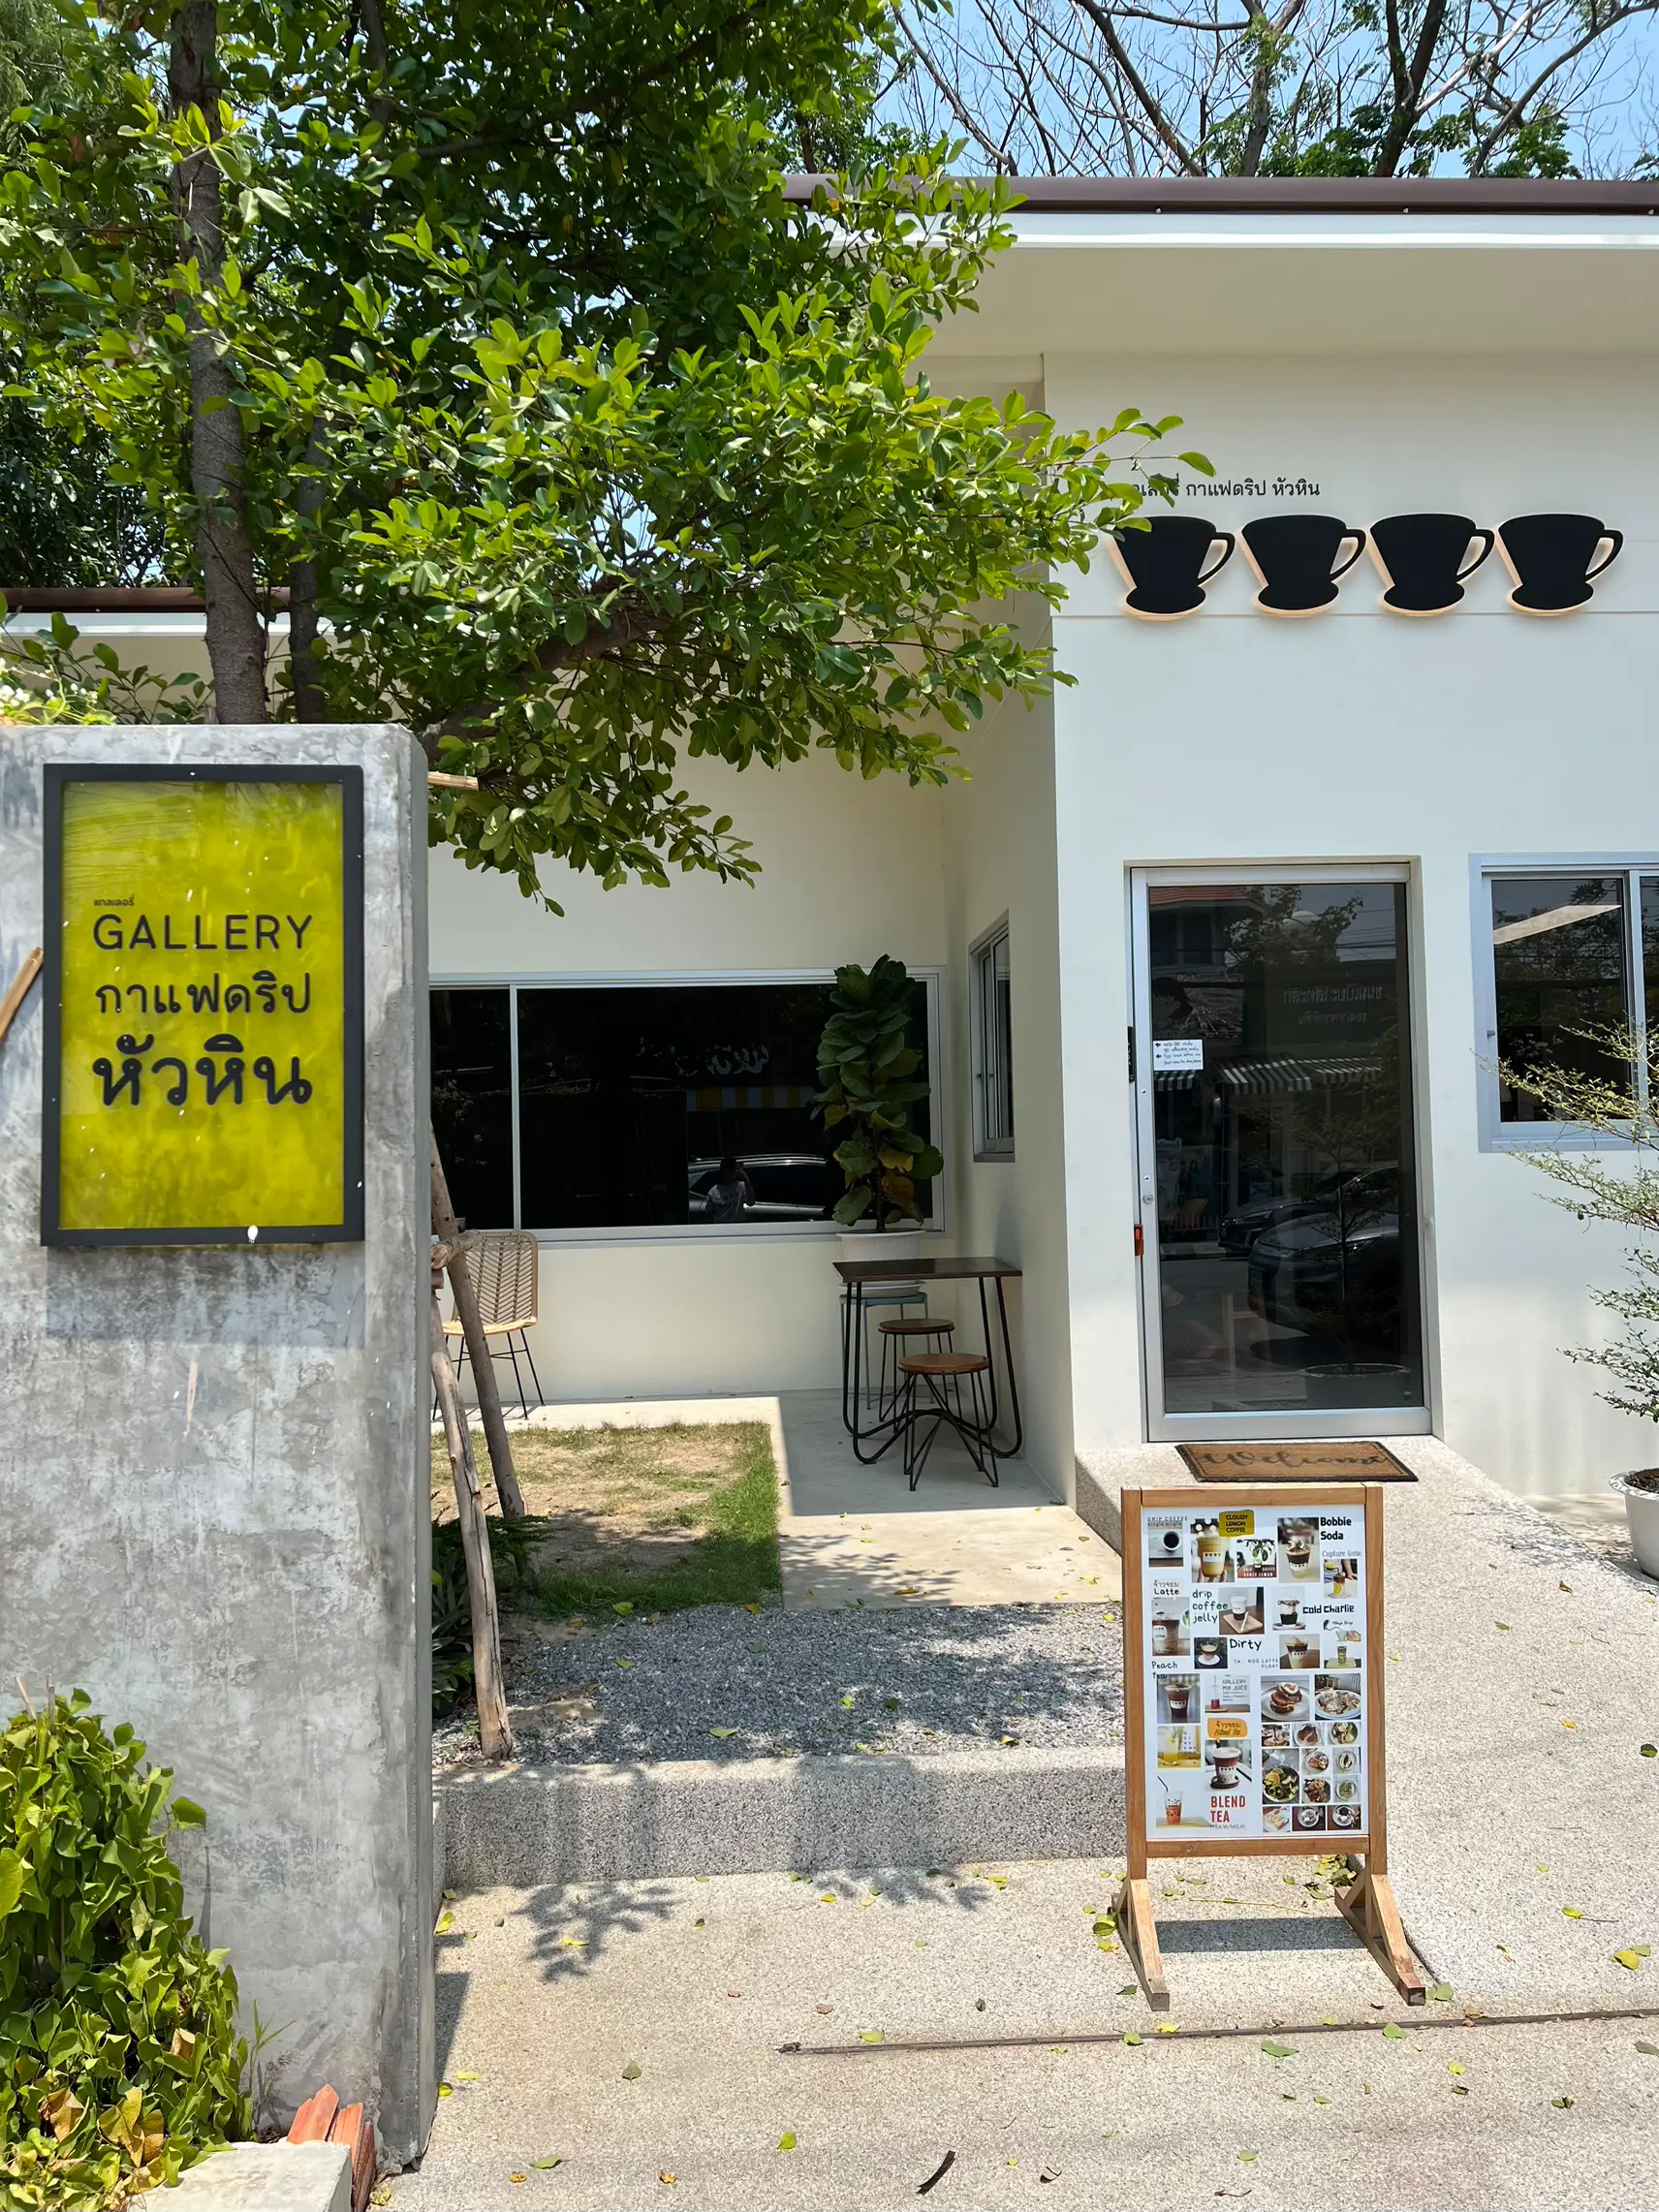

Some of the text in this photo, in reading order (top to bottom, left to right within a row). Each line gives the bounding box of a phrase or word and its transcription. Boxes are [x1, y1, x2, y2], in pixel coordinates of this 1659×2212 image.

[1186, 478, 1266, 496] กาแฟดริป
[1272, 477, 1321, 496] หัวหิน
[93, 914, 312, 950] GALLERY
[95, 970, 311, 1013] กาแฟดริป
[92, 1033, 313, 1106] หัวหิน
[1320, 1516, 1352, 1526] Bobbie
[1320, 1531, 1344, 1541] Soda
[1192, 1589, 1212, 1600] drip
[1192, 1602, 1229, 1610] coffee
[1193, 1612, 1218, 1624] jelly
[1230, 1638, 1262, 1651] Dirty
[1151, 1661, 1177, 1669] Peach
[1210, 1795, 1245, 1808] BLEND
[1210, 1810, 1230, 1823] TEA
